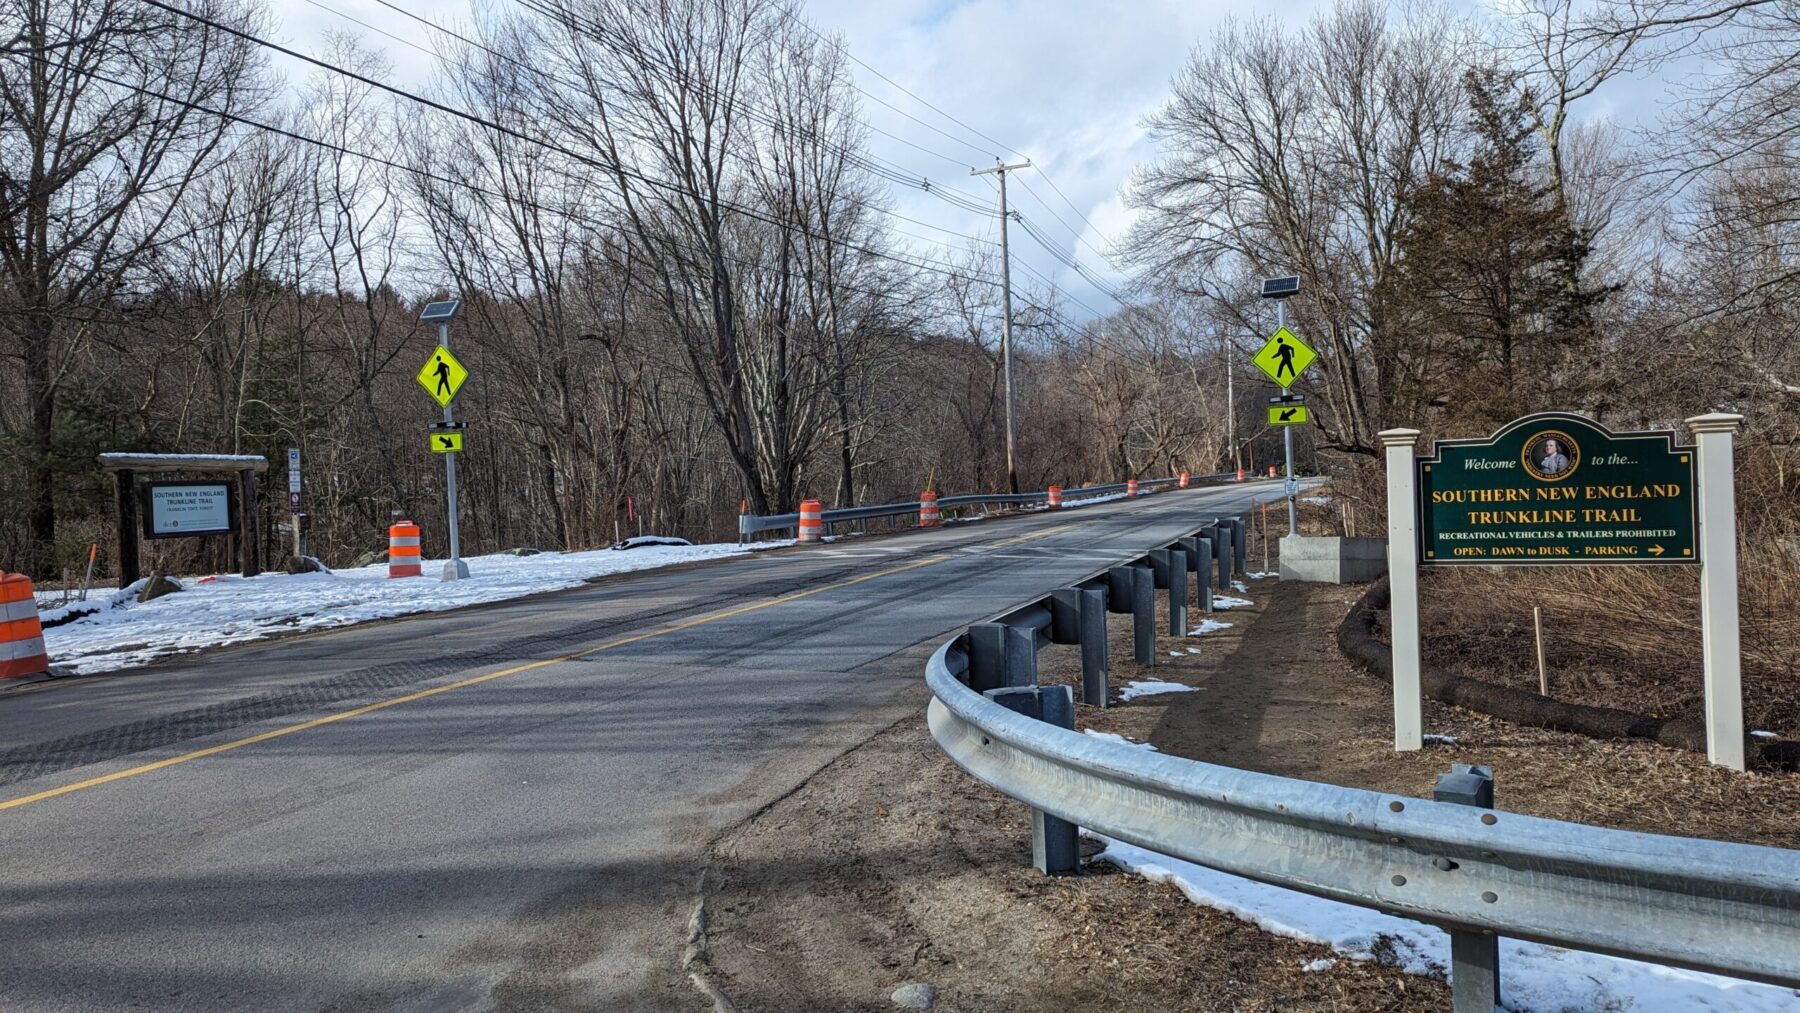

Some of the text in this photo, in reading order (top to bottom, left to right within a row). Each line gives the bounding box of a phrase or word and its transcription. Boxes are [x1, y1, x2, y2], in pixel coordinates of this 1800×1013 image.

[1464, 458, 1516, 470] Welcome
[1591, 455, 1604, 465] to
[1432, 484, 1681, 502] SOUTHERN NEW ENGLAND
[1468, 509, 1642, 523] TRUNKLINE TRAIL
[1439, 532, 1508, 540] RECREATIONAL
[1508, 531, 1555, 539] VEHICLES
[1567, 530, 1613, 538] TRAILERS
[1615, 529, 1676, 537] PROHIBITED
[1453, 547, 1487, 556] OPEN:
[1491, 547, 1525, 556] DAWN
[1527, 547, 1537, 555] to
[1539, 546, 1570, 555] DUSK
[1584, 545, 1638, 555] PARKING
